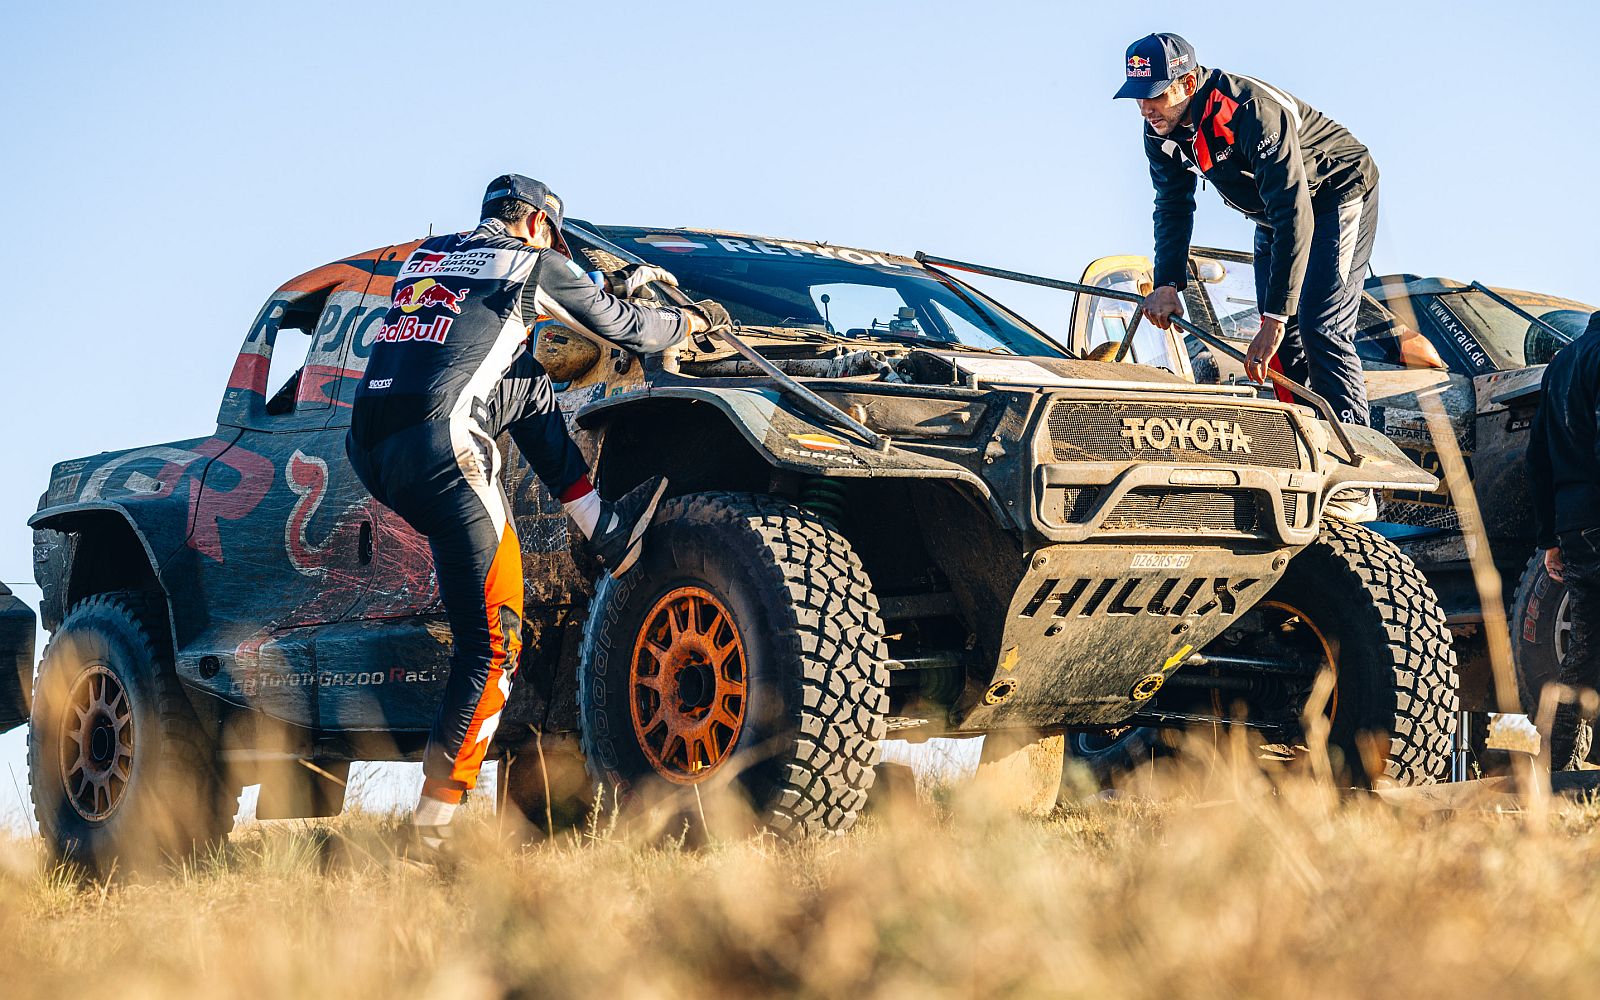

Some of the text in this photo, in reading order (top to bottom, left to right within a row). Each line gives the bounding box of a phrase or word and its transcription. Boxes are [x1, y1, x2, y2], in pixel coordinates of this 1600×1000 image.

[1137, 68, 1151, 77] Bull
[1257, 131, 1278, 151] KINTO
[448, 252, 496, 260] TOYOTA
[716, 238, 901, 269] REPSOL
[404, 259, 437, 274] GR
[433, 266, 480, 275] Racing
[247, 299, 390, 359] RPSO
[375, 315, 454, 344] ed Bull
[1428, 301, 1485, 367] www.x-raid.de
[369, 379, 393, 389] sparco
[1119, 417, 1252, 454] TOYOTA
[1176, 556, 1190, 568] GP
[1018, 577, 1261, 618] HILUX
[320, 670, 385, 687] GAZOO
